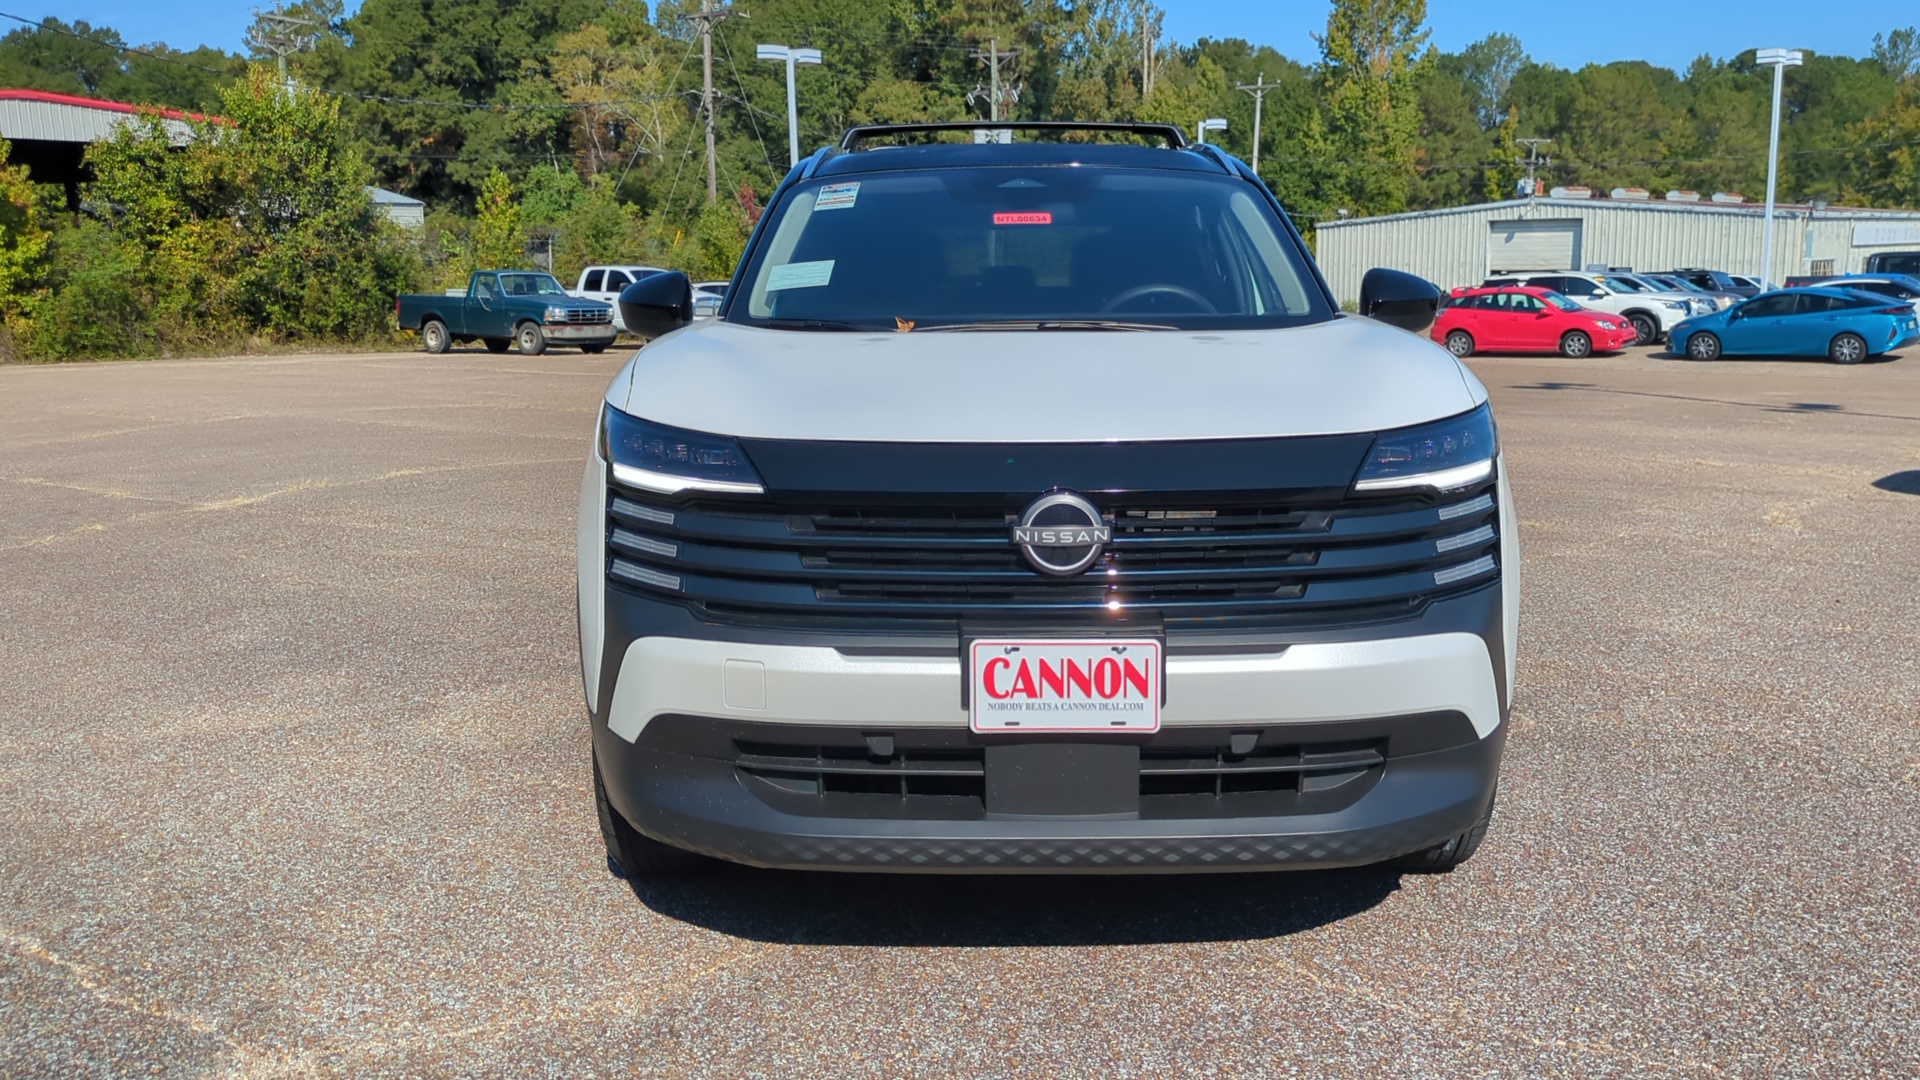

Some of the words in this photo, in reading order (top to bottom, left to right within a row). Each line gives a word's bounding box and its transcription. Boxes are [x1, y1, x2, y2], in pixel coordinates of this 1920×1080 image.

[1015, 529, 1108, 543] NISSAN
[982, 657, 1149, 699] CANNON
[987, 702, 1024, 711] NOBODY
[1025, 702, 1052, 711] BEATS
[1053, 702, 1059, 711] A
[1060, 702, 1098, 711] CANNON
[1098, 701, 1144, 711] DEAL.COM
